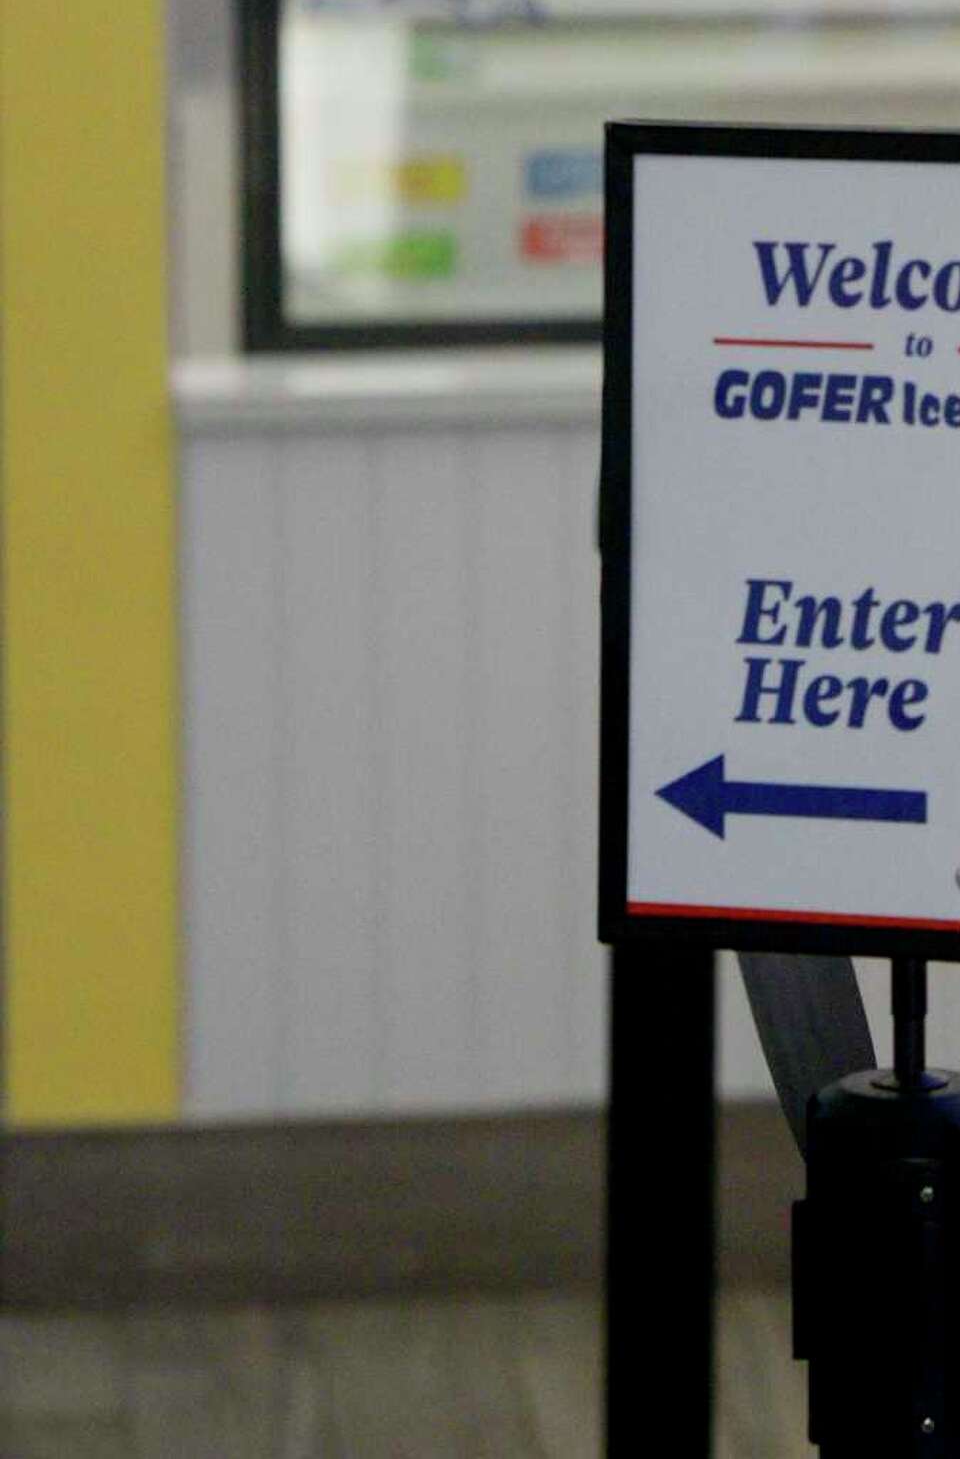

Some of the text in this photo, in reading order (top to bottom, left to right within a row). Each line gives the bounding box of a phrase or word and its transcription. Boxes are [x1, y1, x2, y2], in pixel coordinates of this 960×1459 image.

[904, 331, 934, 359] to
[714, 369, 895, 425] GOFER
[734, 657, 930, 732] Here
